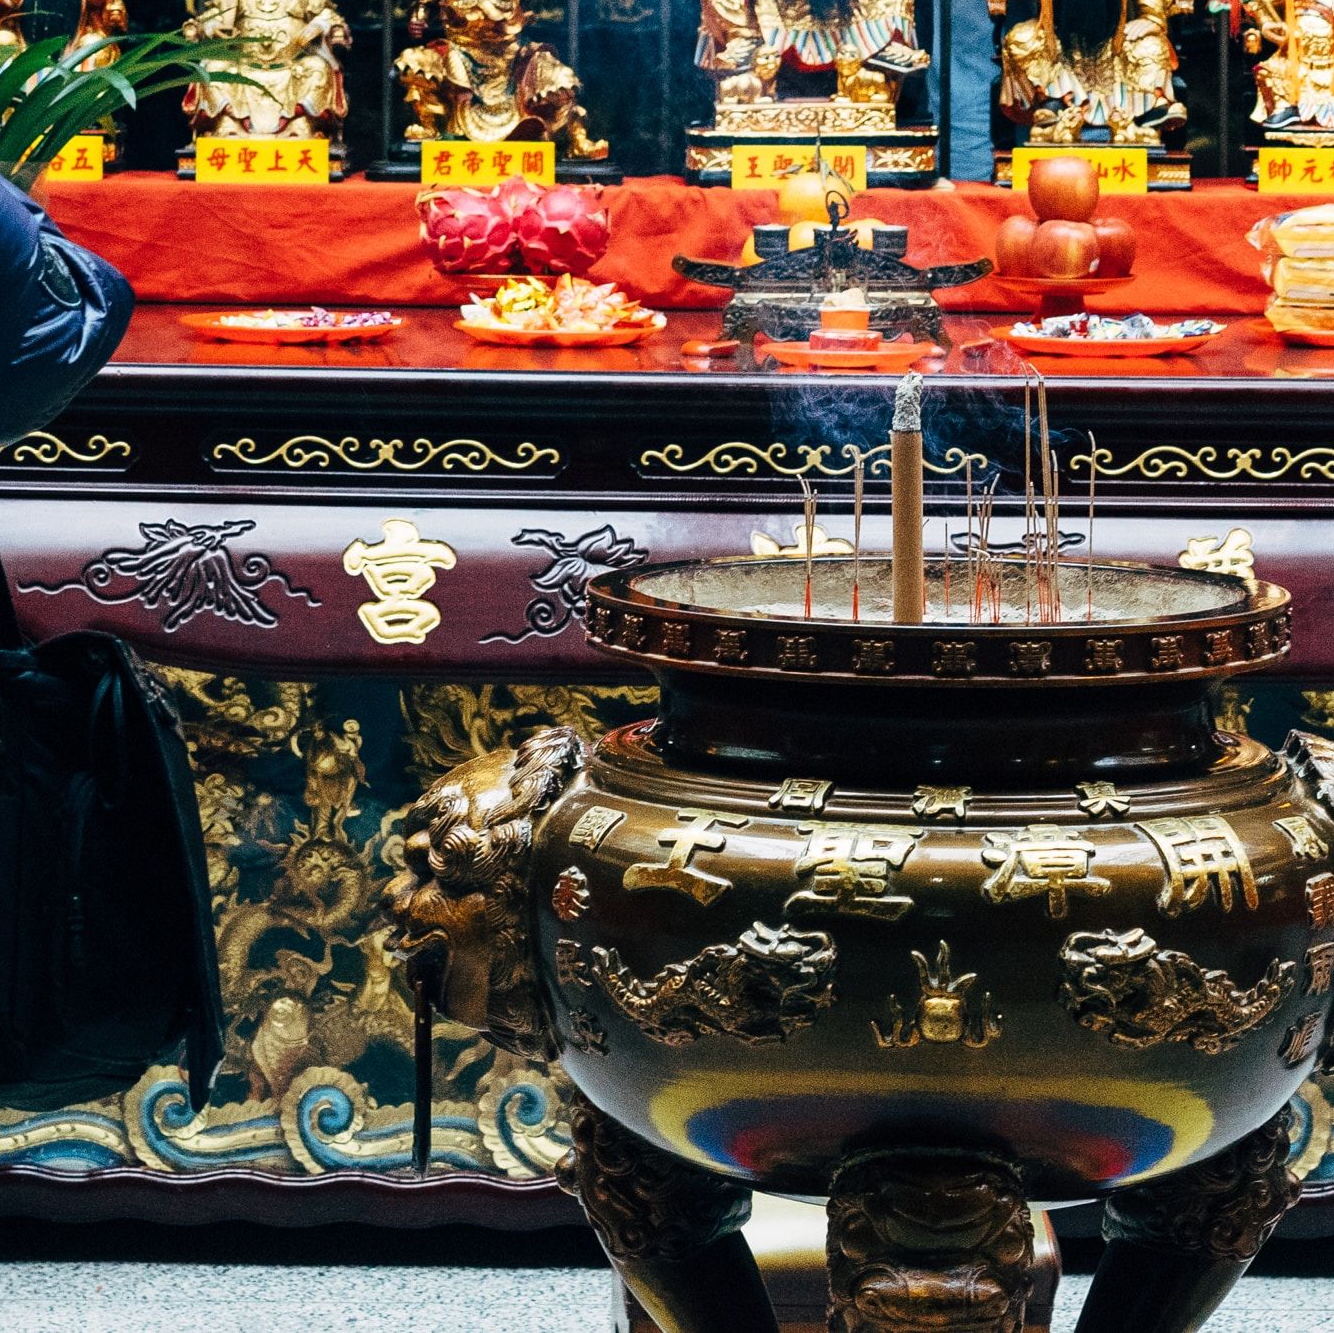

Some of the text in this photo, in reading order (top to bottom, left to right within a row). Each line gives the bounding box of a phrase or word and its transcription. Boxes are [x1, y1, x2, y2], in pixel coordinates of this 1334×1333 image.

[206, 146, 319, 173] 天上聖母
[343, 519, 457, 645] 宮
